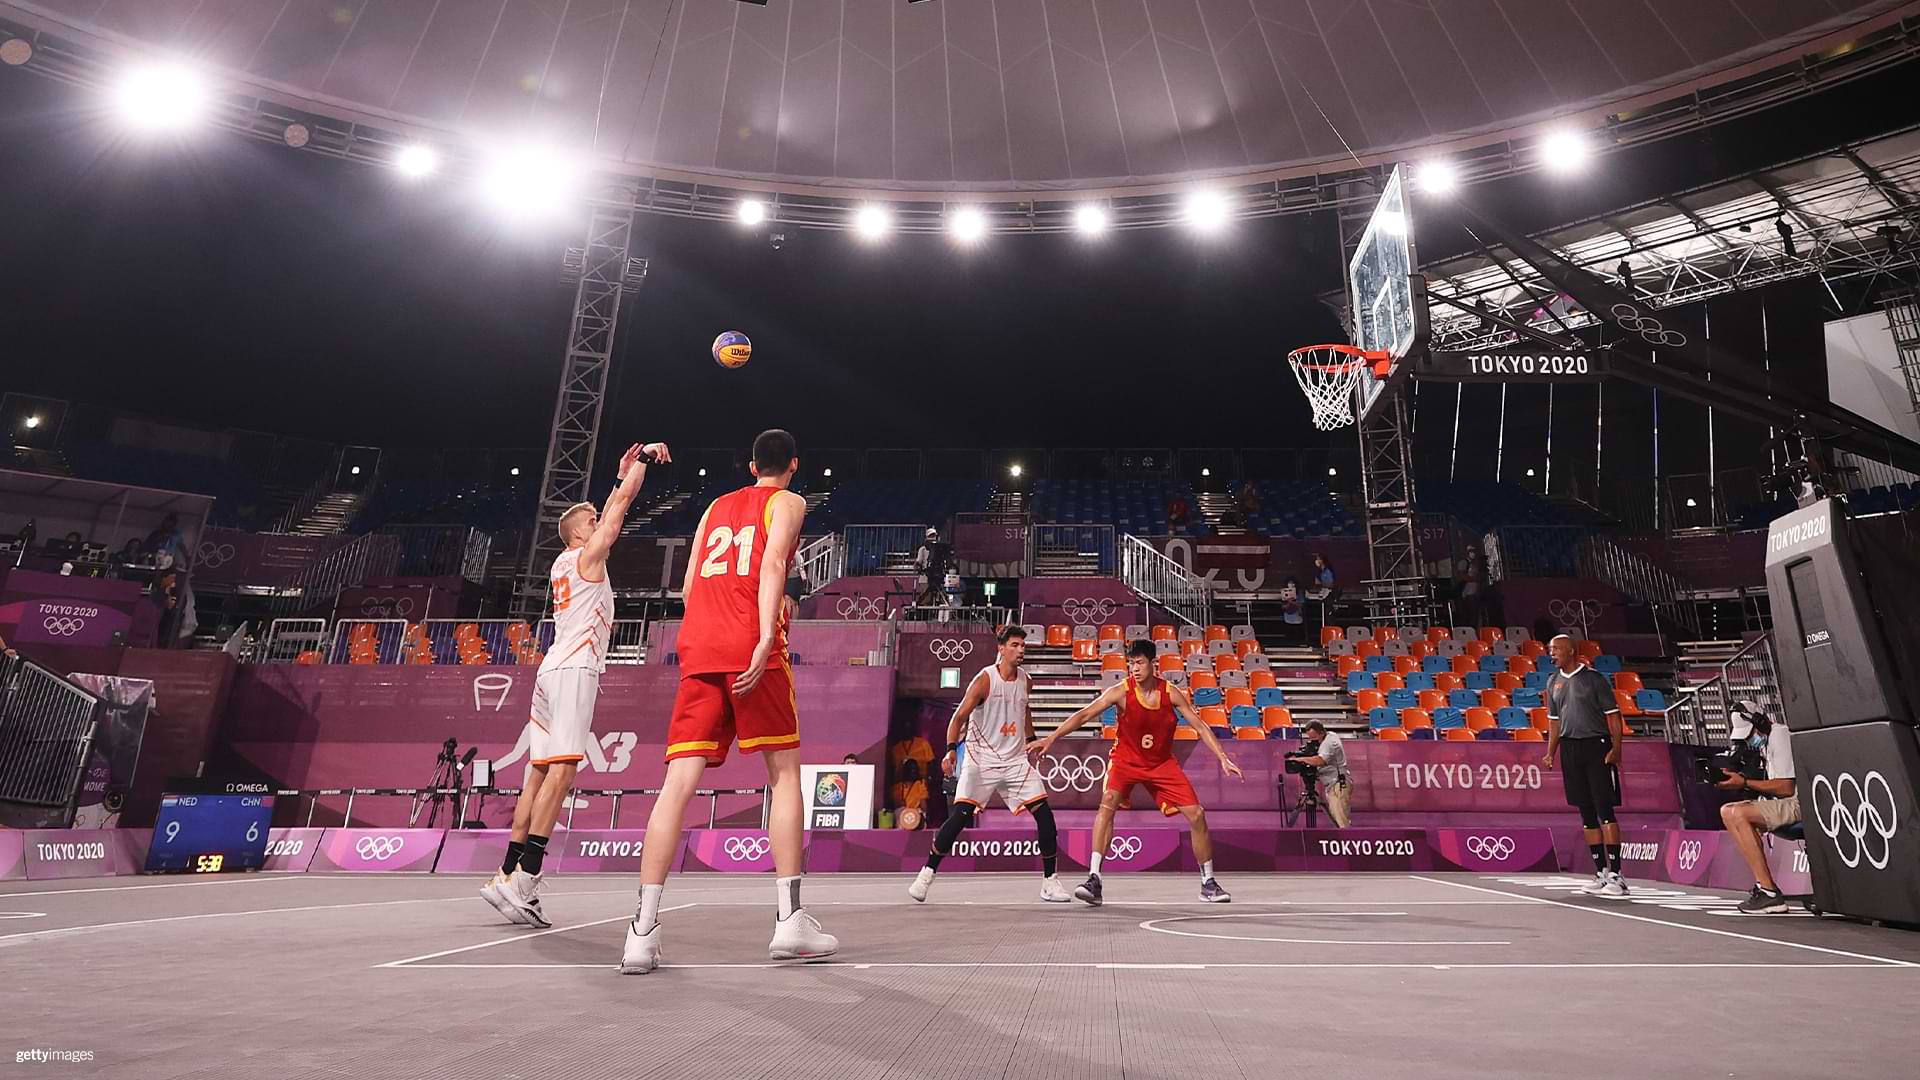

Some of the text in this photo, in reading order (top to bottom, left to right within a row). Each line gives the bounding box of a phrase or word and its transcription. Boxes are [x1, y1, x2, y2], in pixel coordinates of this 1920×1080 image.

[1468, 355, 1588, 374] TOKYO 2020
[1005, 528, 1025, 539] S16
[1423, 528, 1444, 540] S17
[1771, 515, 1826, 553] TOKYO 2020
[700, 525, 756, 578] 21
[39, 604, 98, 617] TOKYO 2020
[1812, 630, 1830, 643] OMEGA
[1000, 721, 1017, 737] 44
[1141, 734, 1154, 749] 6
[1388, 763, 1542, 790] TOKYO 2020
[236, 783, 269, 793] OMEGA
[178, 797, 198, 806] NED
[241, 797, 261, 806] CHN
[815, 813, 840, 827] FIBA
[166, 821, 180, 843] 9
[246, 821, 259, 842] 6
[37, 842, 105, 861] TOKYO 2020
[264, 840, 304, 856] 2020
[580, 841, 631, 857] TOKYO
[951, 840, 1041, 857] TOKYO 2020
[1319, 840, 1415, 856] TOKYO 2020
[1620, 842, 1659, 860] TOKYO 2020
[196, 855, 224, 873] 5:38
